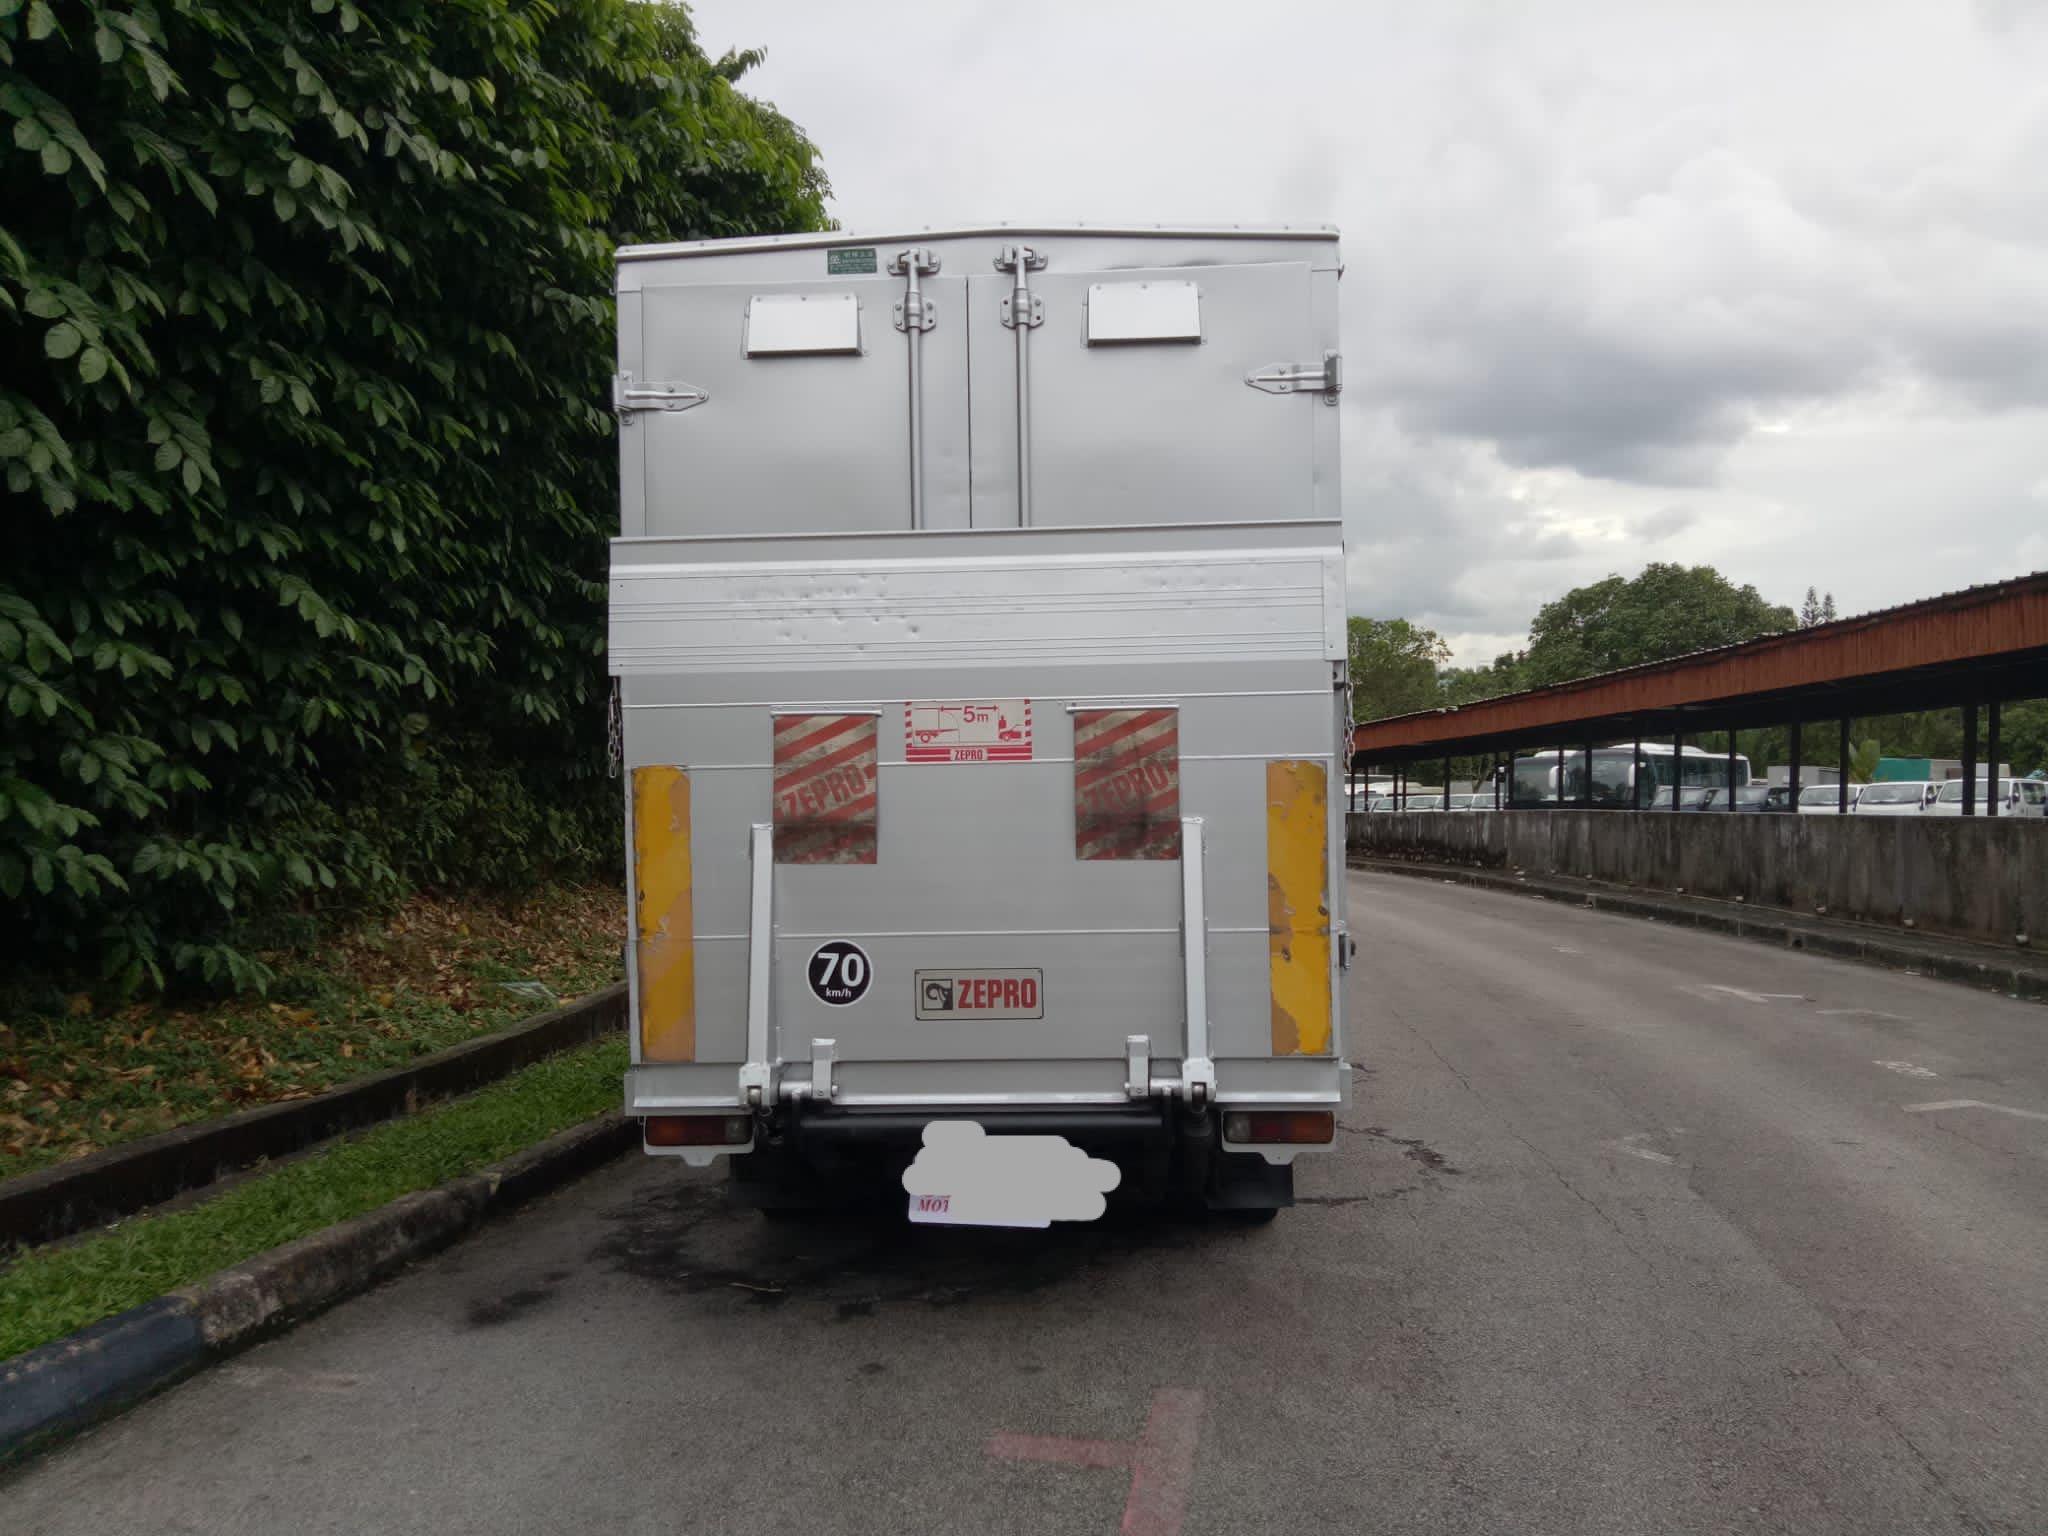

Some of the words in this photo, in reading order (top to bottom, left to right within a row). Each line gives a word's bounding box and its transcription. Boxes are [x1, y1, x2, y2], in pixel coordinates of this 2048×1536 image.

[963, 705, 989, 723] 5m
[954, 749, 984, 761] ZEPRO
[782, 763, 866, 817] ZEPRO
[1083, 759, 1169, 815] ZEPRO
[817, 952, 865, 987] 70
[825, 987, 852, 998] km/h
[957, 978, 1037, 1009] ZEPRO
